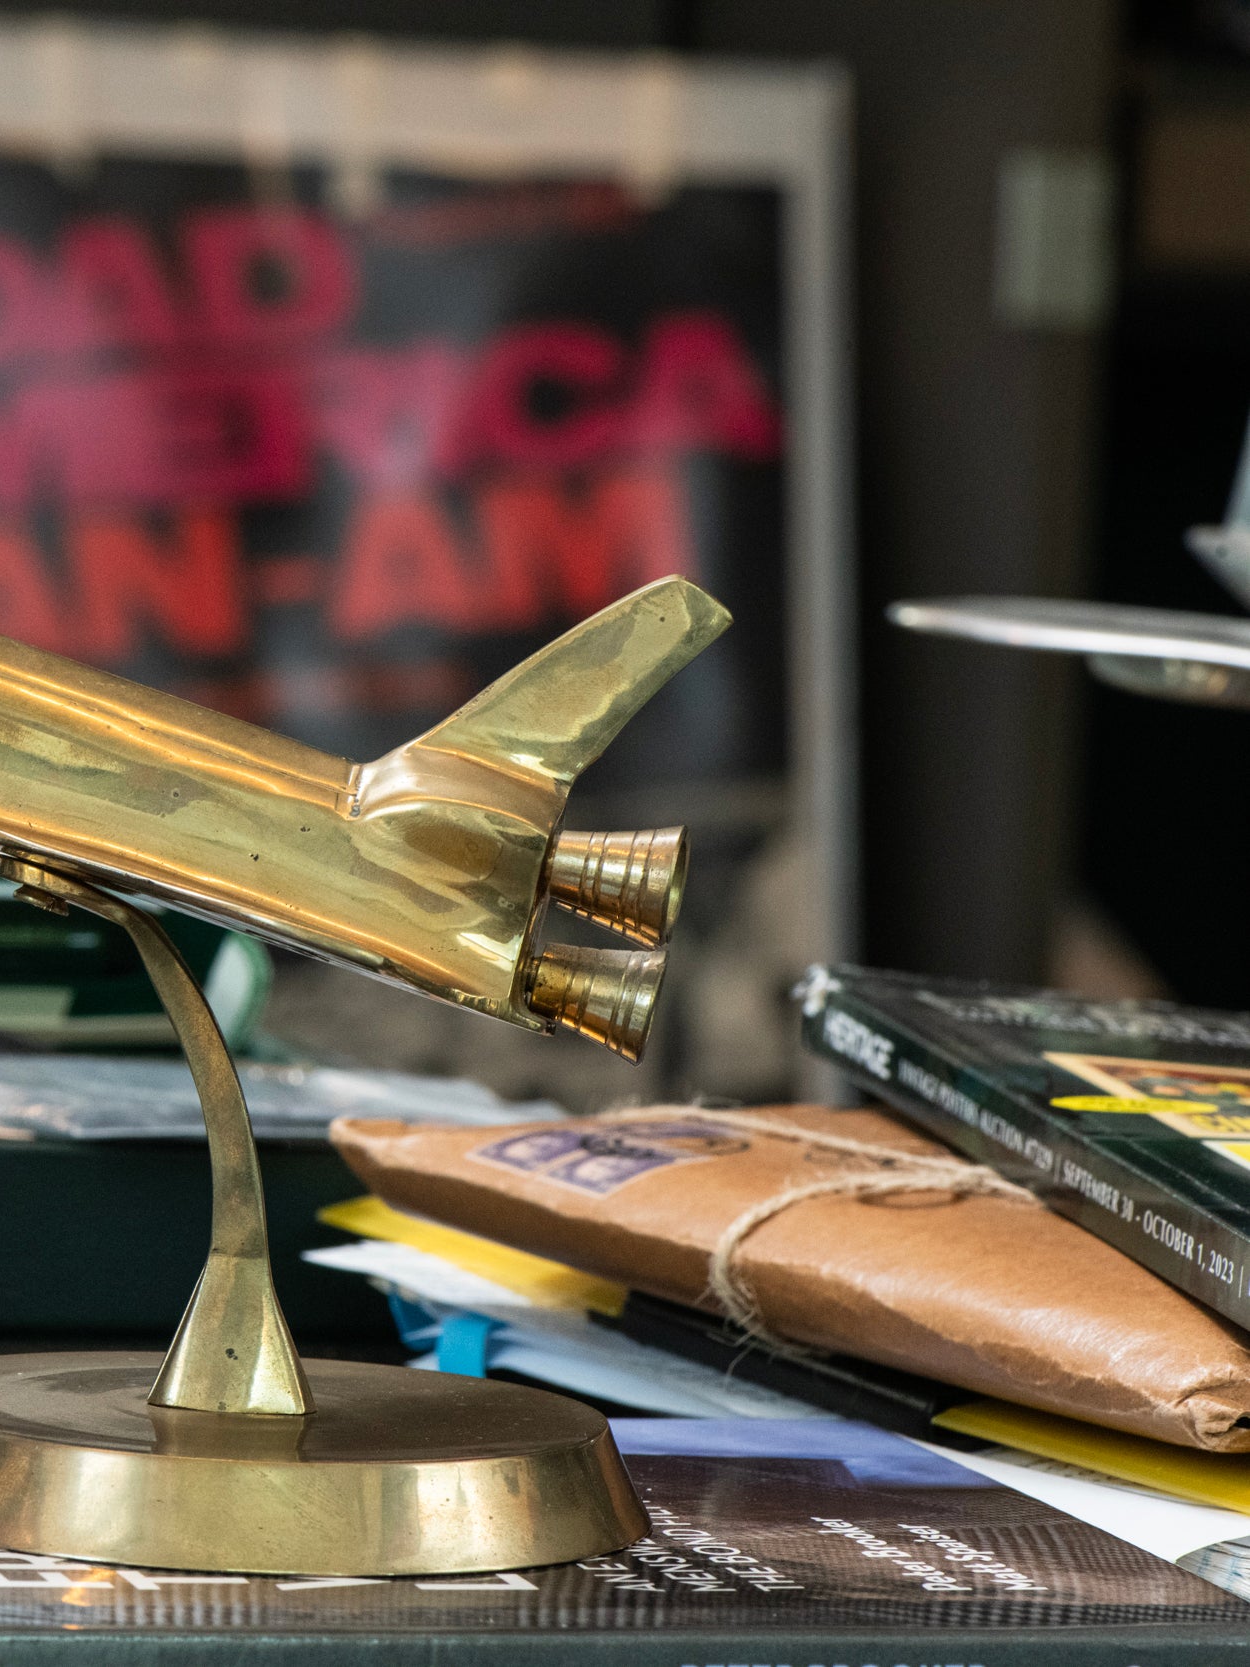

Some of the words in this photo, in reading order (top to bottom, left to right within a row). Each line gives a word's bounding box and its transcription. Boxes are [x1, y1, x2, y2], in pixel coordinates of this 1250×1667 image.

[1062, 1159, 1120, 1214] SEPTEMBER
[1121, 1194, 1135, 1223] 30
[1142, 1209, 1195, 1260] OCTOBER
[1197, 1243, 1206, 1271] 1,
[1208, 1249, 1235, 1284] 2023
[661, 1528, 760, 1565] BOND
[810, 1516, 912, 1558] Brooker
[898, 1523, 995, 1562] Spaiser
[594, 1573, 667, 1593] AN
[726, 1566, 806, 1592] THE
[892, 1559, 973, 1591] Peter
[962, 1562, 1049, 1591] Matt
